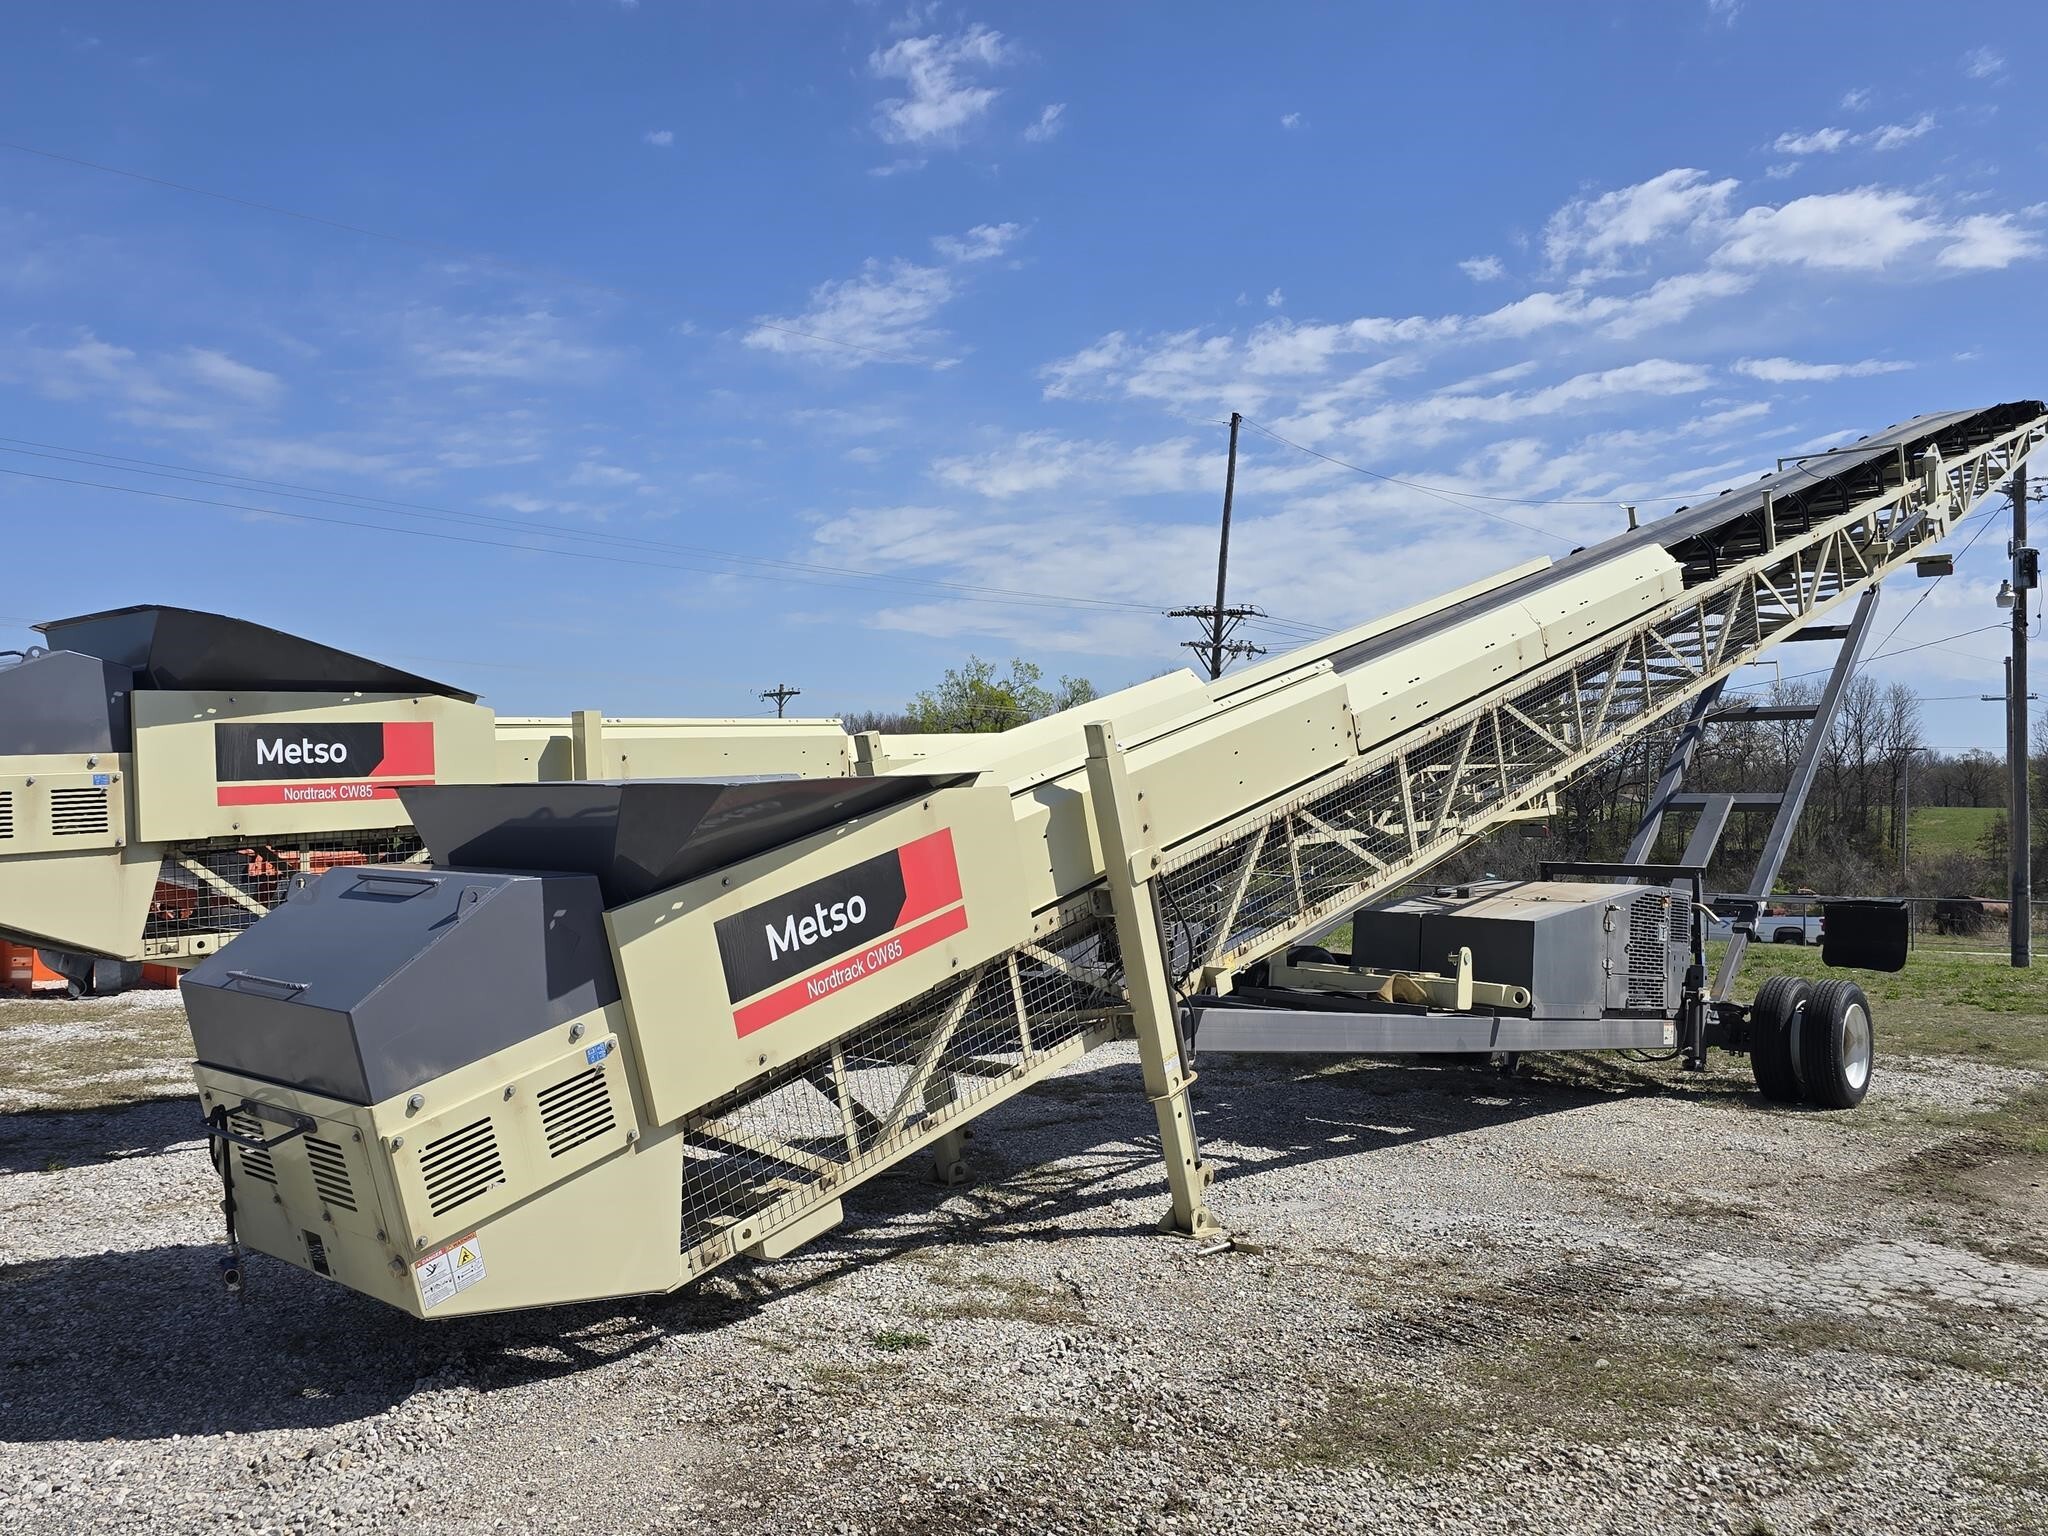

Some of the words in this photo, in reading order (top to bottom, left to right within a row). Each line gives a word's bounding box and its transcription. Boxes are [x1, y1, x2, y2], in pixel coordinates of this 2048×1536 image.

[256, 738, 347, 765] Metso
[284, 786, 337, 801] Nordtrack
[339, 784, 373, 799] CW85
[765, 895, 867, 961] Metso
[806, 960, 866, 999] Nordtrack
[866, 939, 903, 970] CW85
